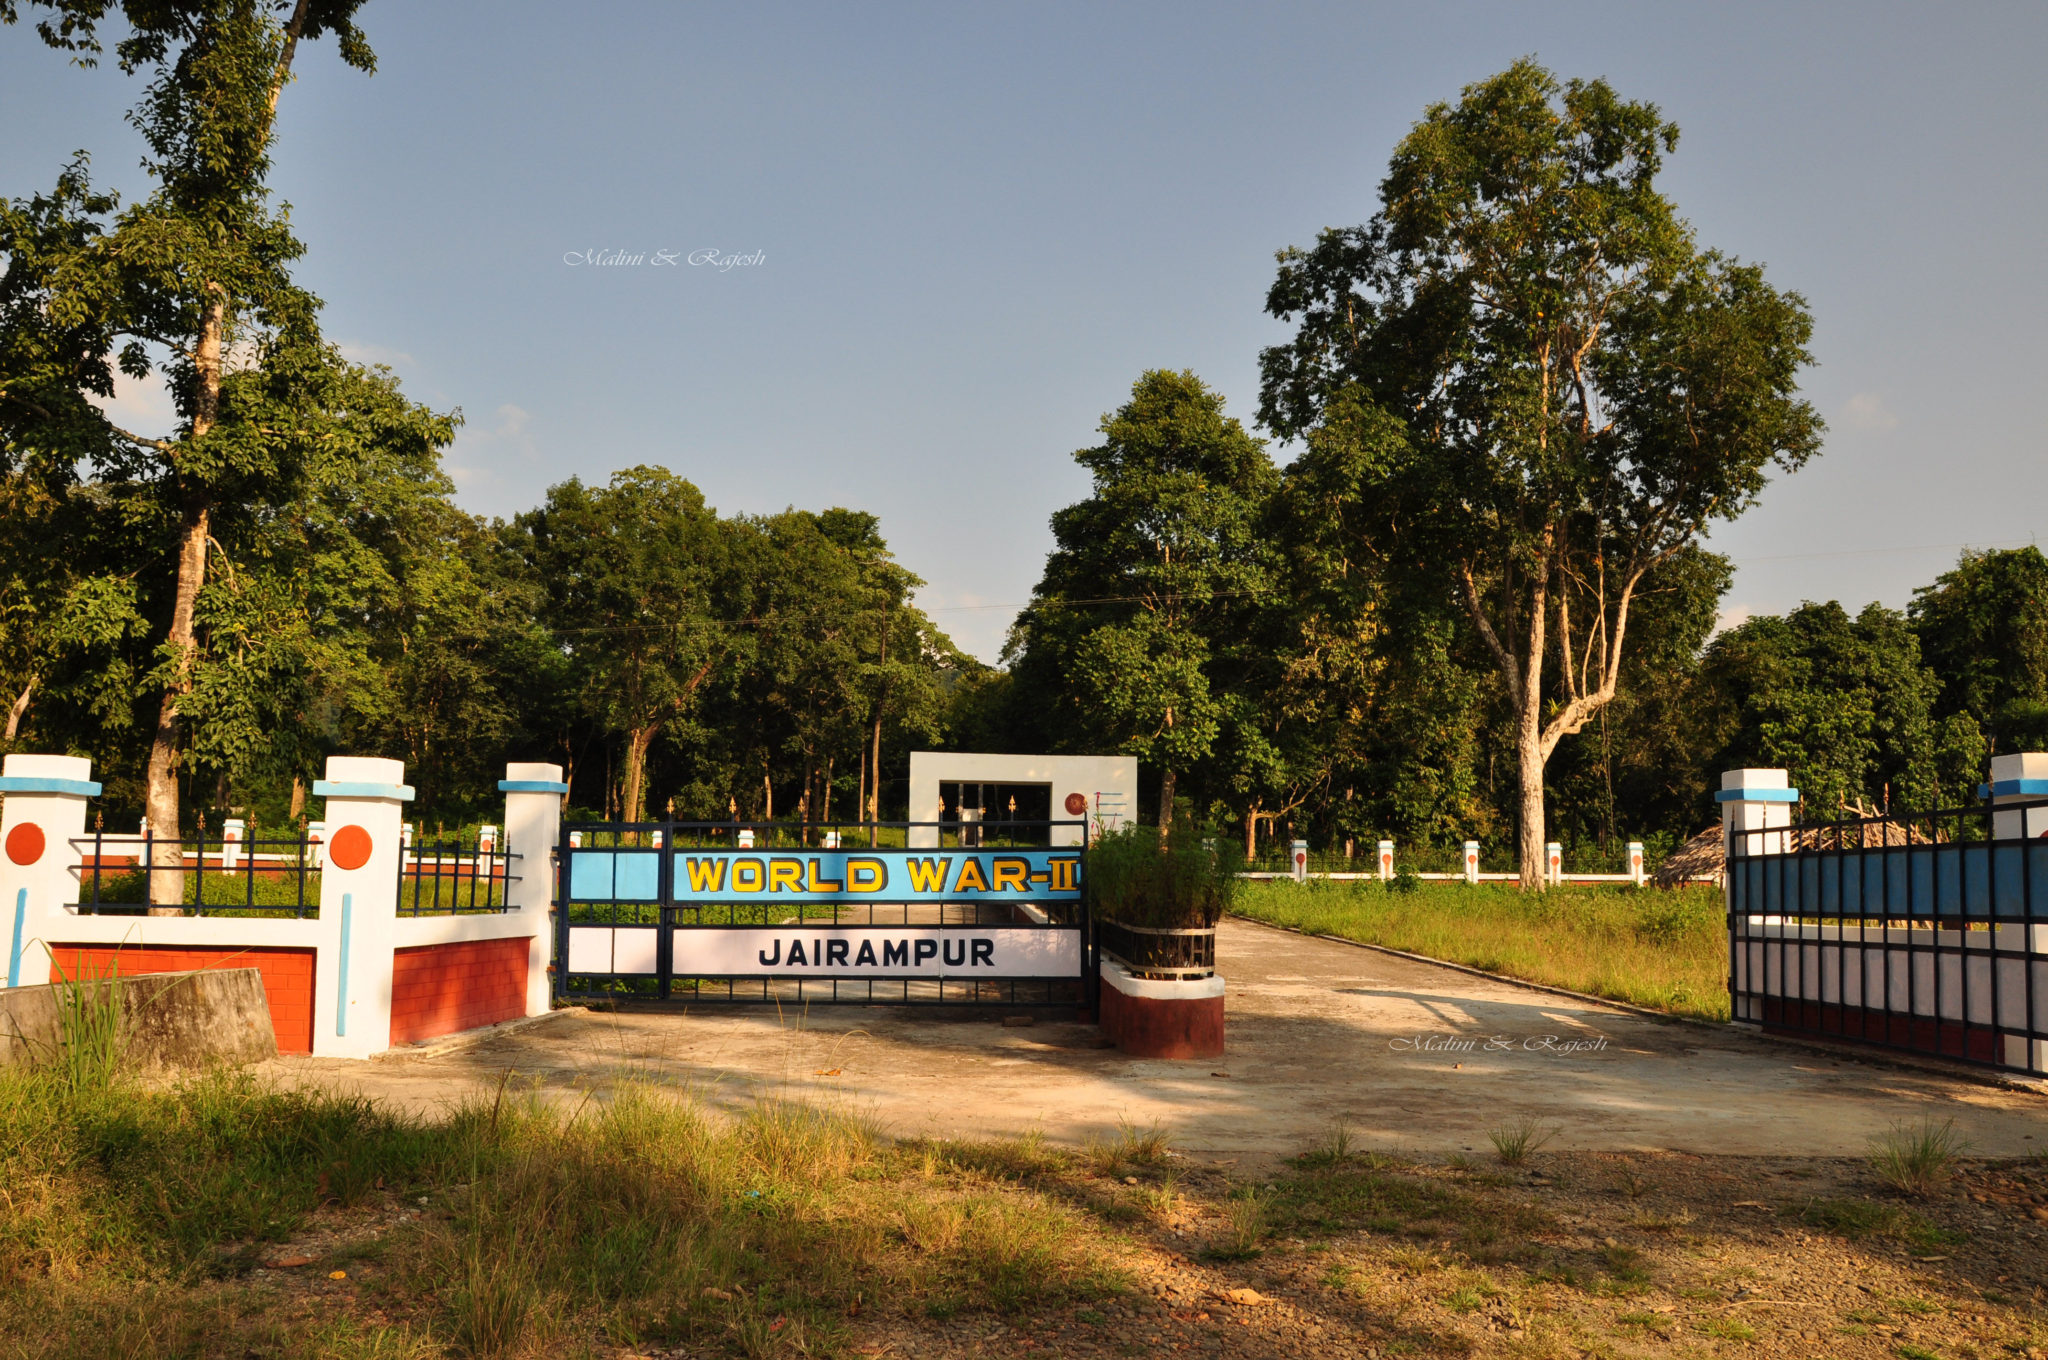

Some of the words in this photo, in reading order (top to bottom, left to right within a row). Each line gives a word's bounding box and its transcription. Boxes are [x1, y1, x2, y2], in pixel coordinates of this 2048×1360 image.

[686, 856, 889, 893] WORLD
[906, 856, 1080, 892] WAR-II
[759, 939, 994, 967] JAIRAMPUR
